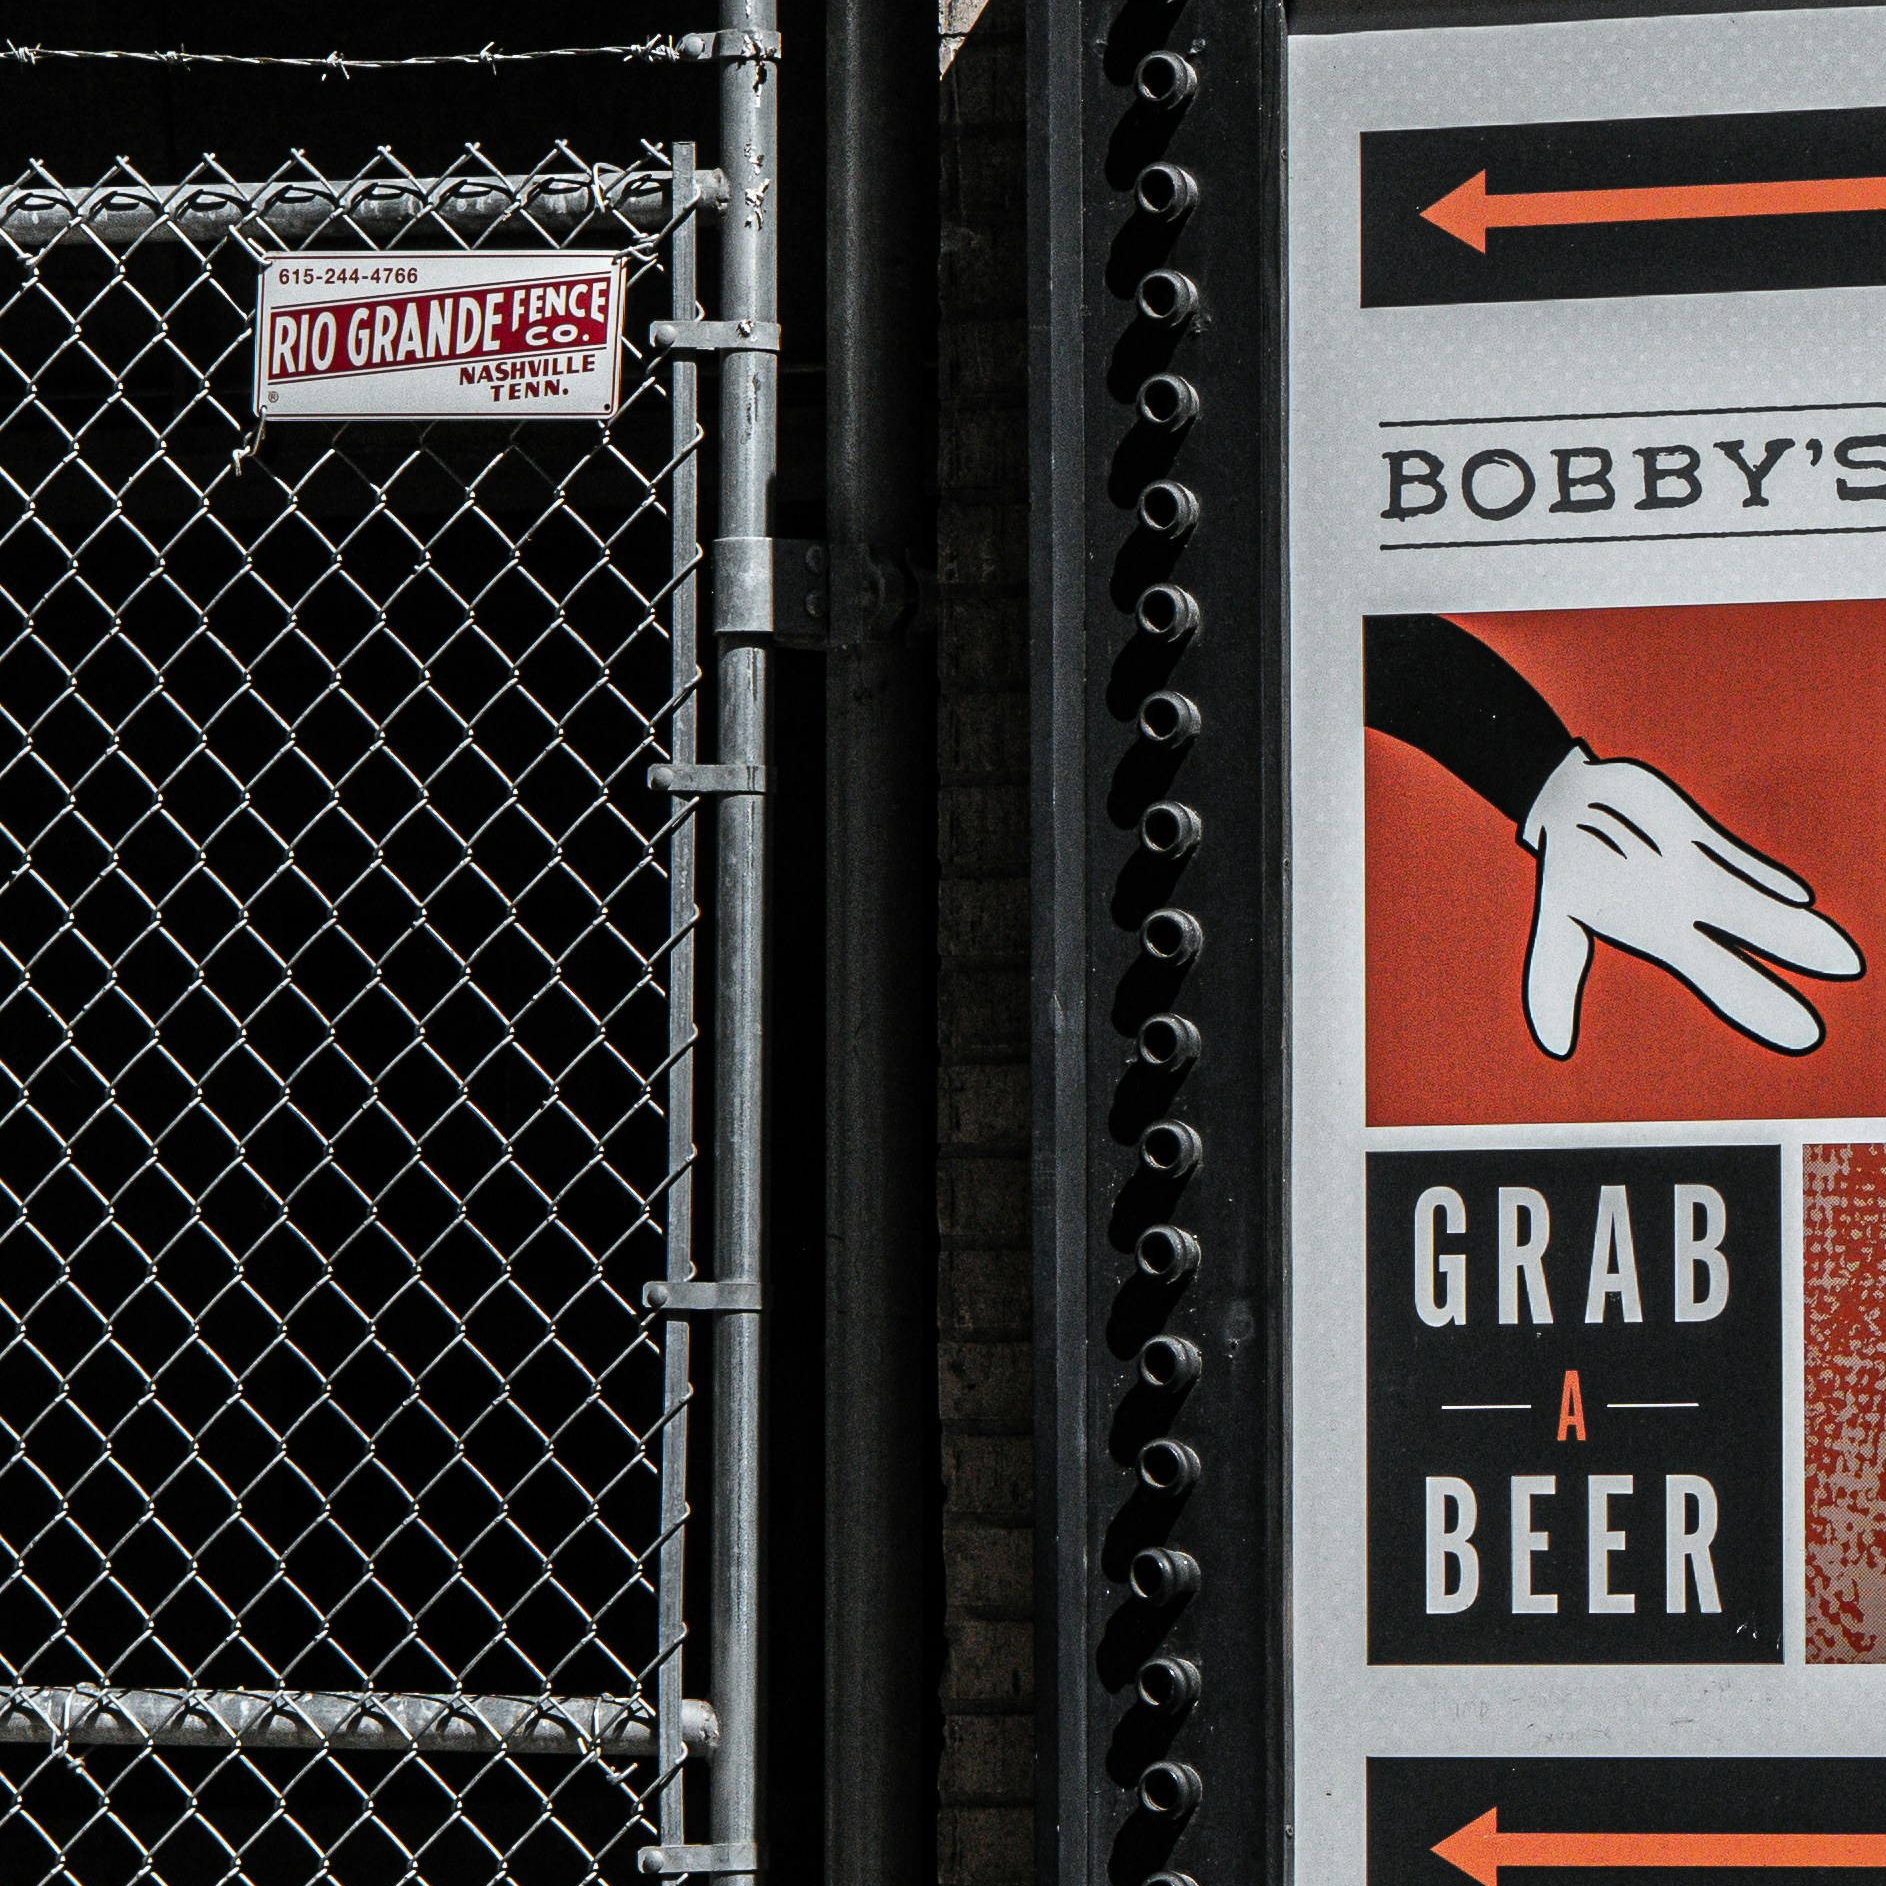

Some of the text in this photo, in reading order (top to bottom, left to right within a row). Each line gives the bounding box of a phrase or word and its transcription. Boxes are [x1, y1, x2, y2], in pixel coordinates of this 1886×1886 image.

[278, 267, 418, 285] 615-244-4766
[272, 281, 608, 375] RIO GRANDE FENCE
[525, 323, 590, 346] CO.
[459, 353, 596, 386] NASHVILLE
[489, 378, 569, 402] TENN.
[1413, 1183, 1730, 1328] GRAB
[1556, 1369, 1587, 1442] A
[1424, 1473, 1723, 1614] BEER
